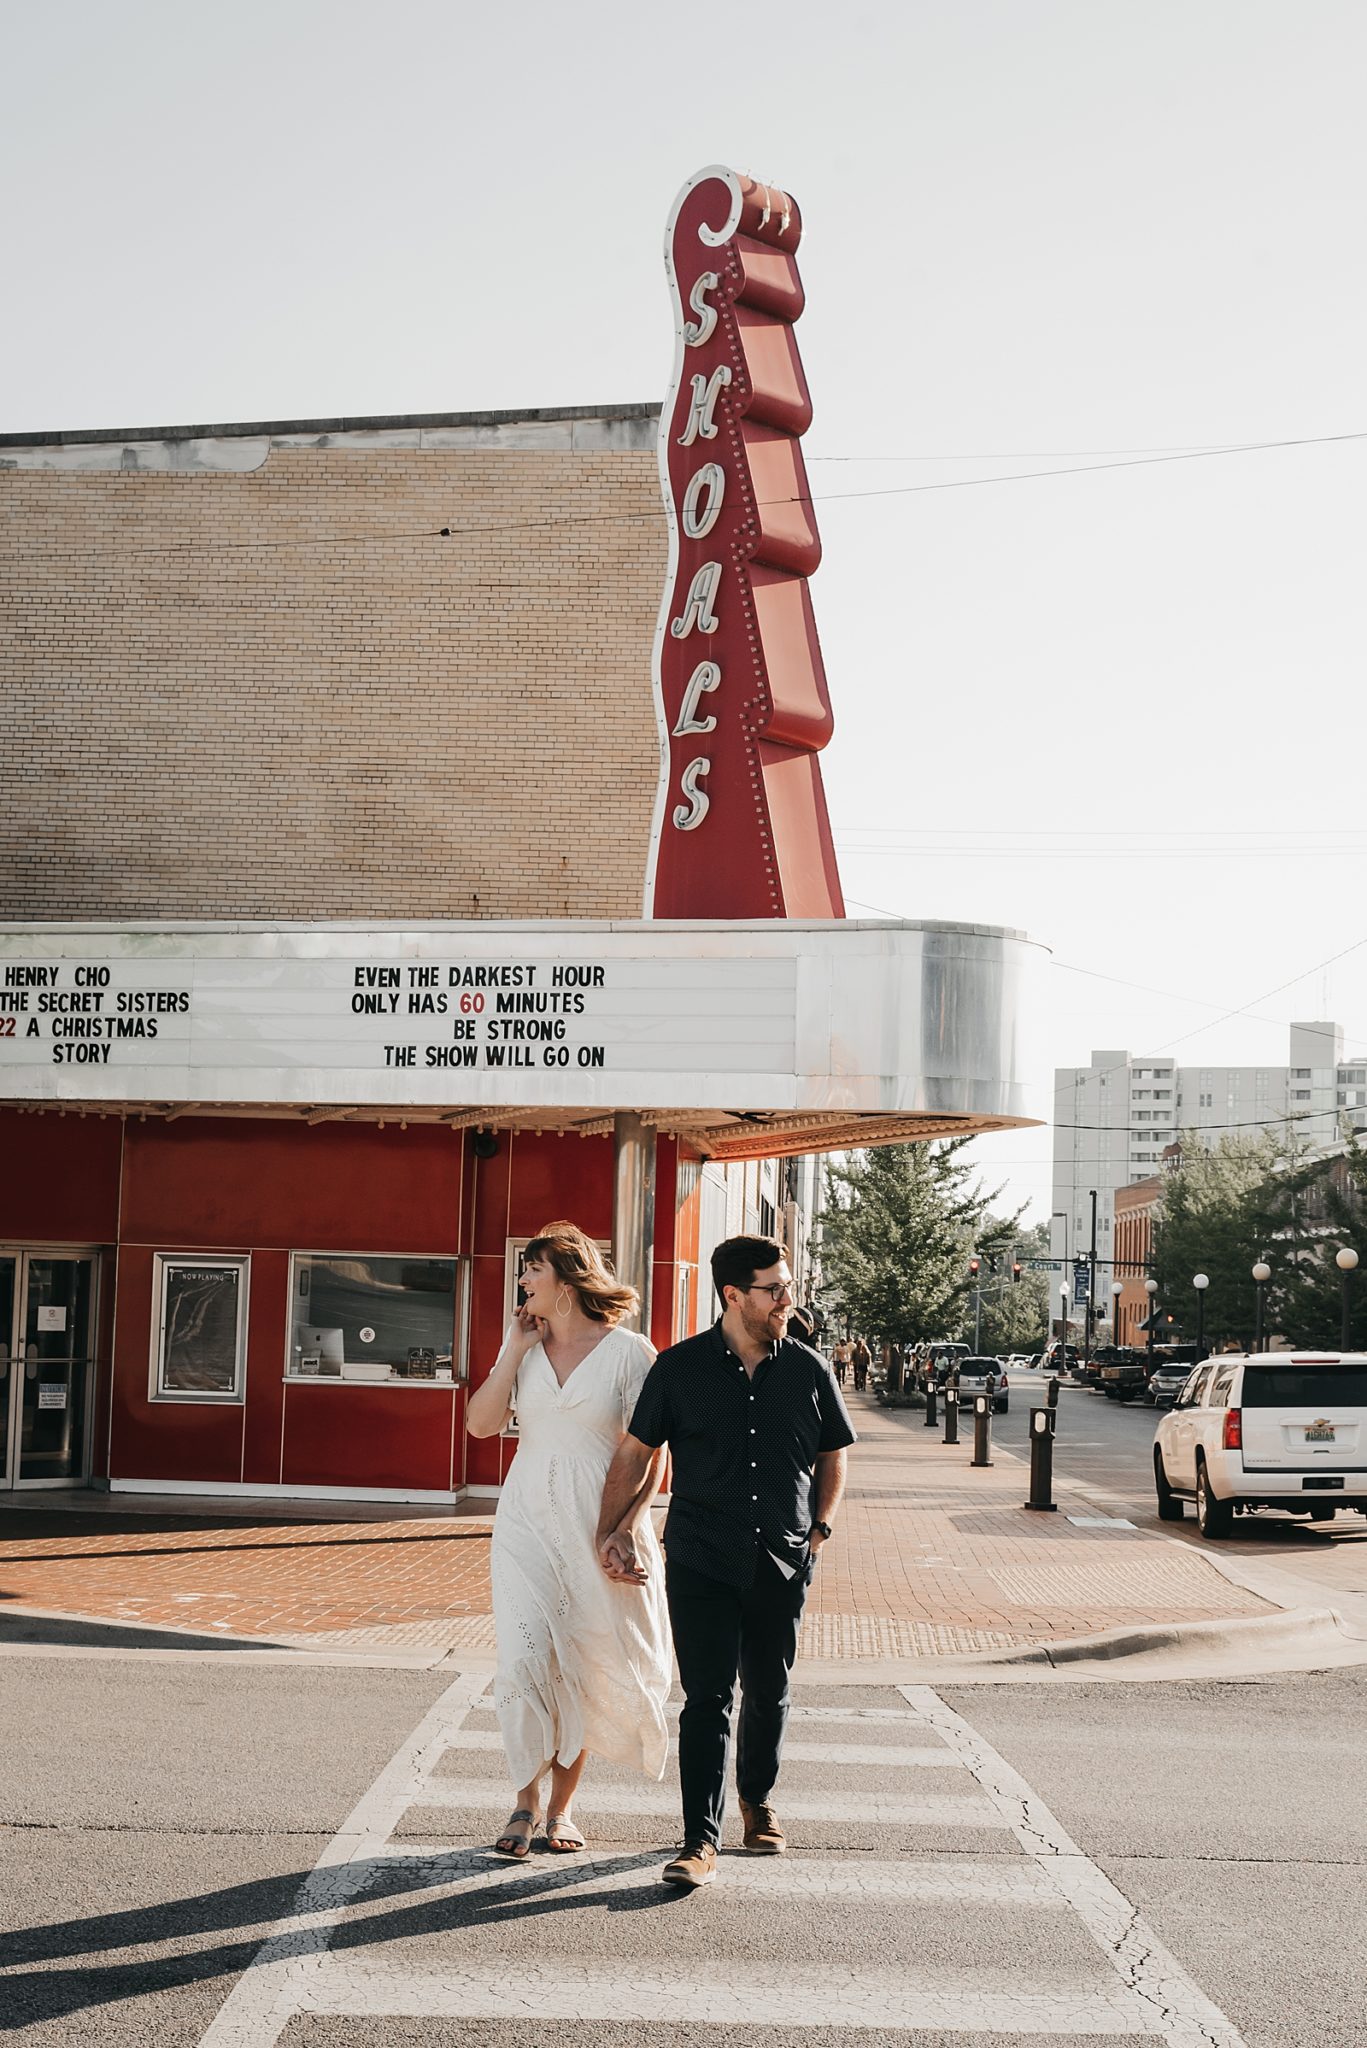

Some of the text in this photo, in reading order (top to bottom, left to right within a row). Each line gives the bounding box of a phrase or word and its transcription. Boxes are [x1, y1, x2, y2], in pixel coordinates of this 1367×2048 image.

[671, 271, 732, 831] SHOALS
[4, 966, 111, 987] HENRY CHO
[354, 965, 605, 988] EVEN THE DARKEST HOUR
[0, 991, 190, 1013] THE SECRET SISTERS
[351, 992, 585, 1015] ONLY HAS 60 MINUTES
[26, 1017, 40, 1038] A
[52, 1017, 158, 1039] CHRISTMAS
[453, 1019, 566, 1041] BE STRONG
[52, 1043, 111, 1064] STORY
[384, 1045, 605, 1067] THE SHOW WILL GO ON
